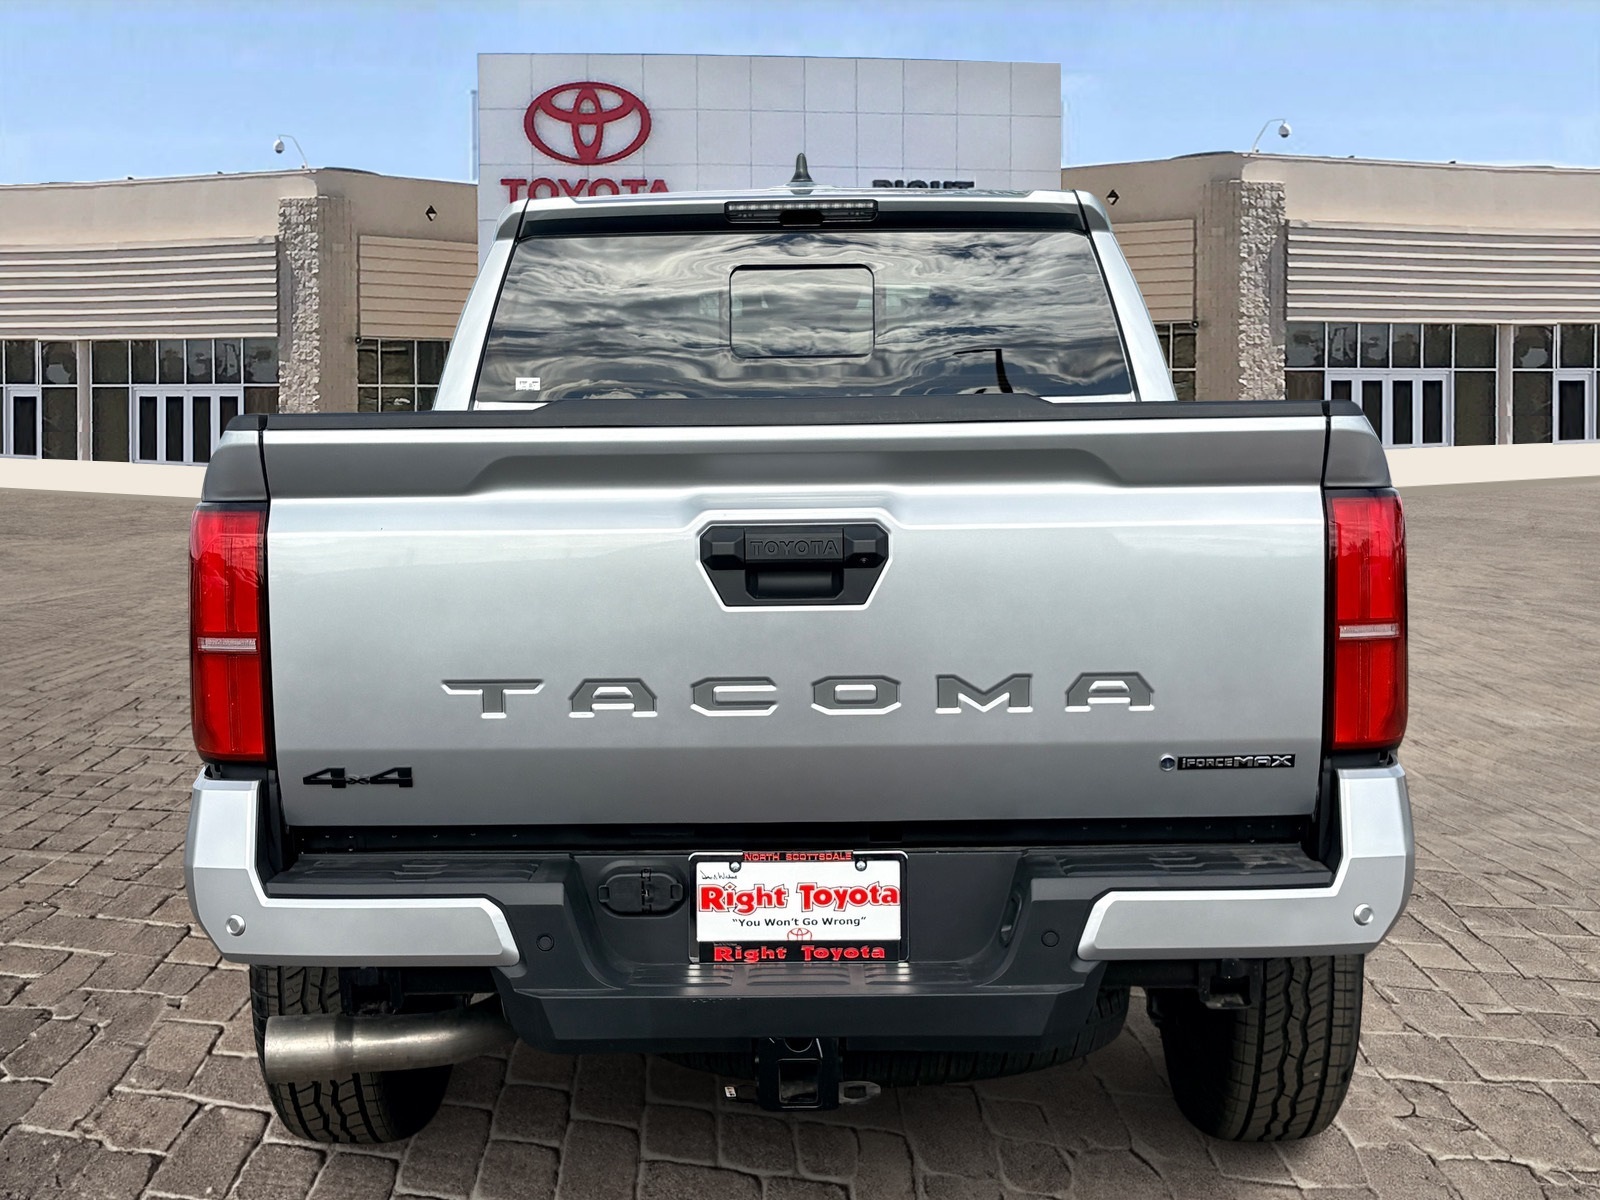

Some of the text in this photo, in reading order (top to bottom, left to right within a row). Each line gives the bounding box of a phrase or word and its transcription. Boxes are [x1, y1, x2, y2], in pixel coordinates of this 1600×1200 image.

[750, 540, 839, 556] TOYOTA
[441, 671, 1156, 720] TACOMA
[744, 851, 852, 861] NORTH SCOTTSDALE
[698, 881, 900, 915] Right Toyota
[764, 917, 799, 926] Won't
[802, 917, 818, 926] Go
[713, 945, 886, 963] Right Toyota
